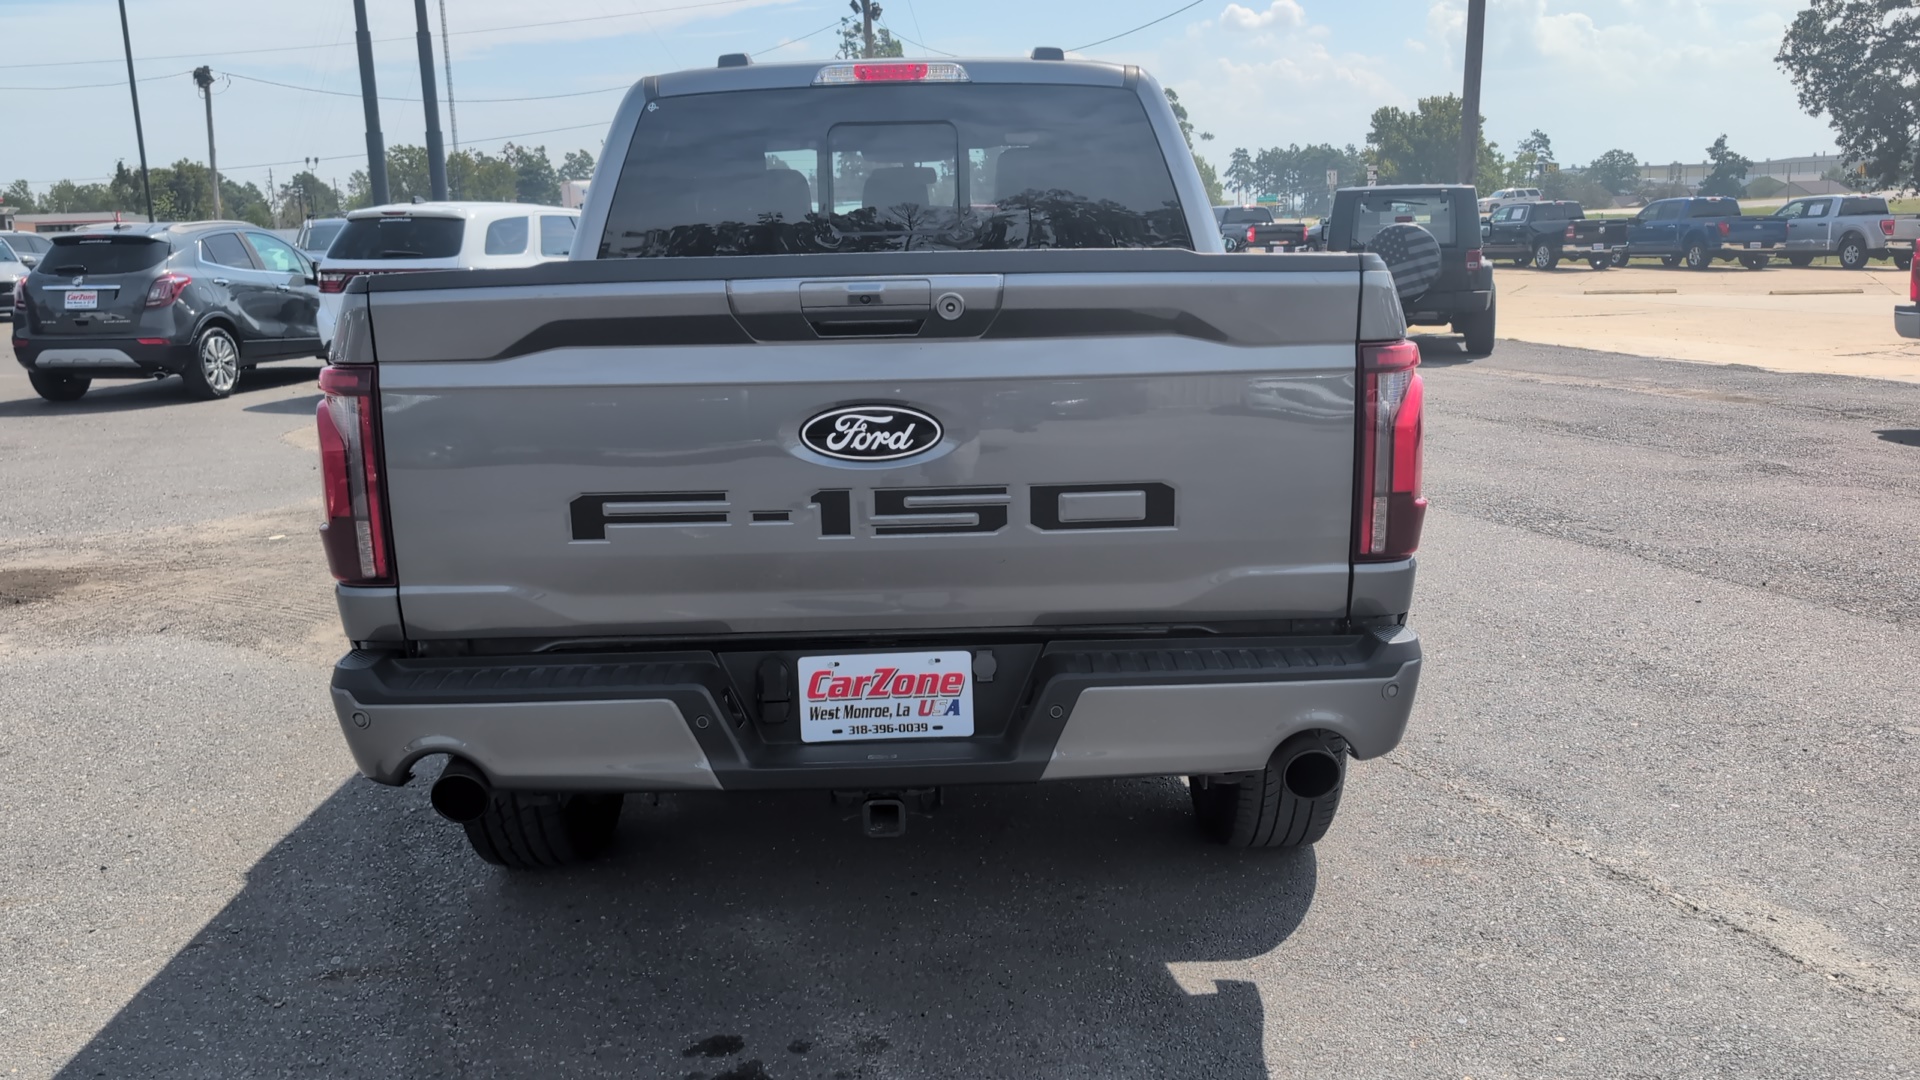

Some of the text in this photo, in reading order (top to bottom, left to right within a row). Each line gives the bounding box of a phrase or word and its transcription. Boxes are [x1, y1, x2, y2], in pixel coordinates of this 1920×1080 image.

[826, 414, 916, 451] Ford
[569, 480, 1177, 543] F-150
[807, 668, 966, 702] CarZone
[809, 698, 960, 721] West Monroe, La USA
[848, 722, 929, 735] 318-396-0039
